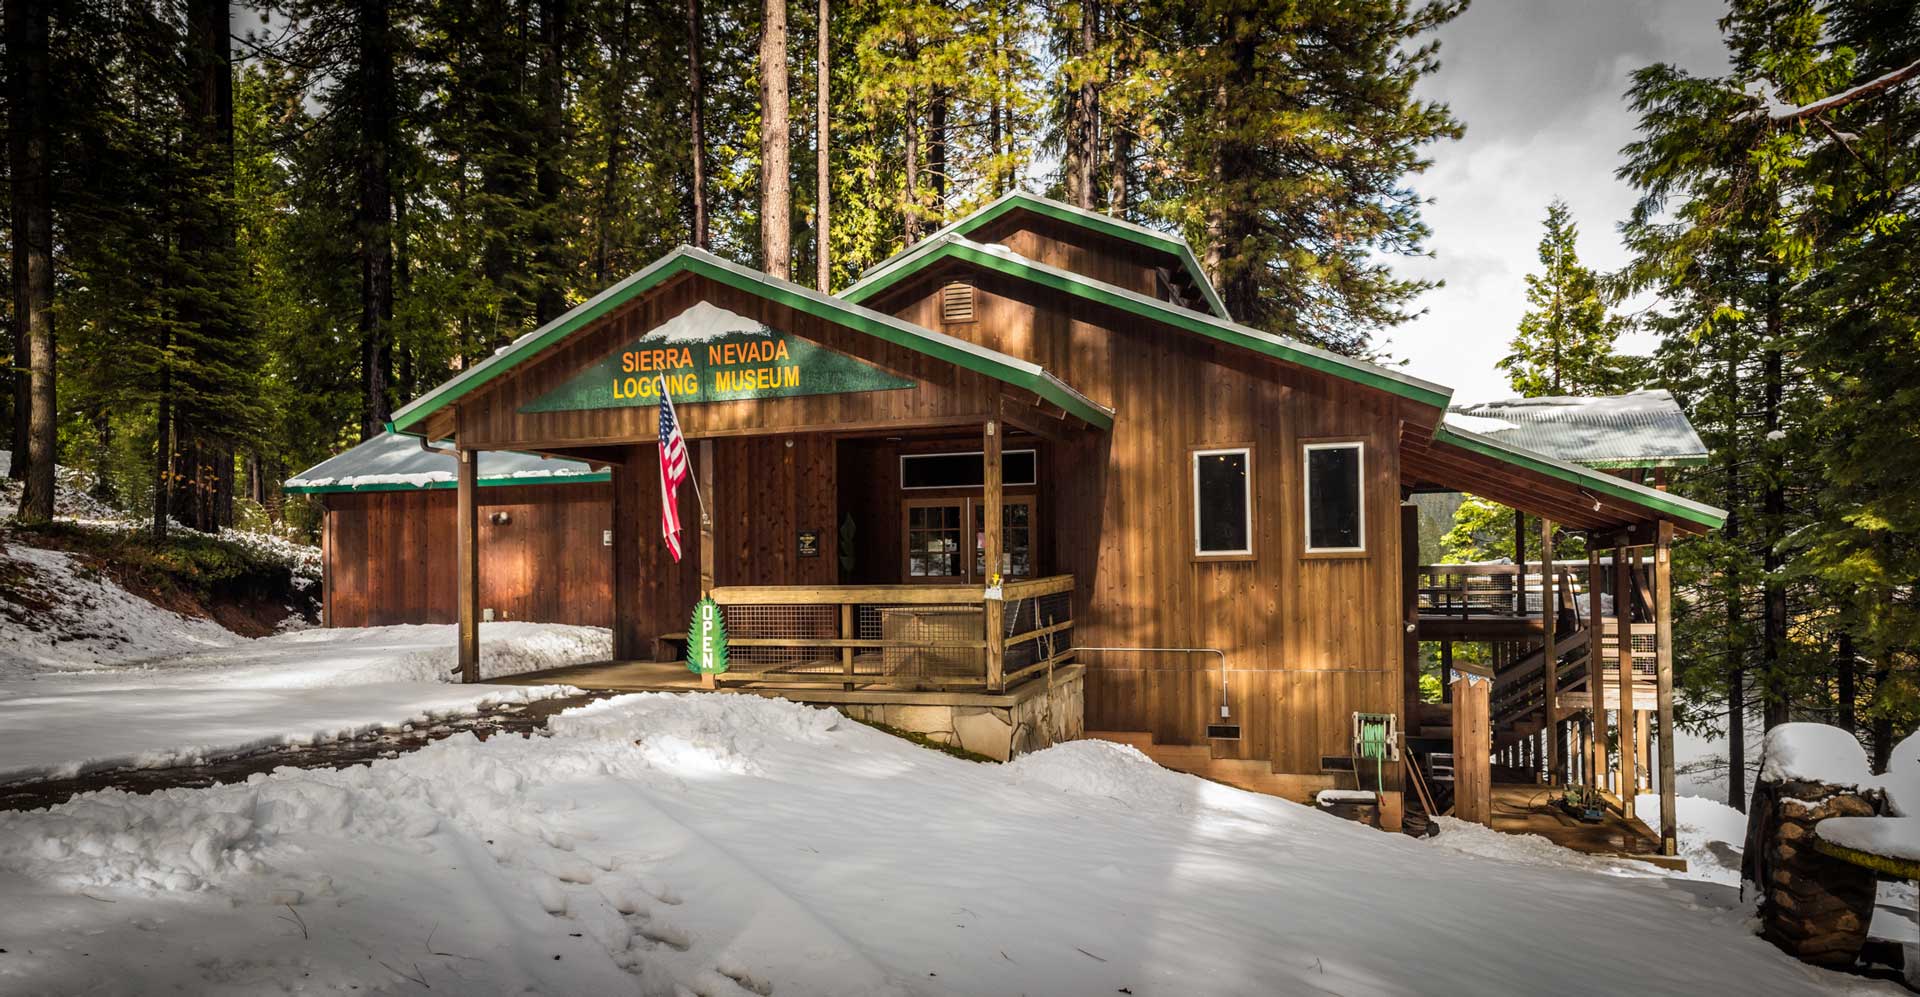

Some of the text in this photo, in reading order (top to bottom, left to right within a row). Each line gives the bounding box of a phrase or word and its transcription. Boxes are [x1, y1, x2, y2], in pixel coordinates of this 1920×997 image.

[622, 339, 790, 373] SIERRA NEVADA
[613, 365, 800, 399] LOGGING MUSEUM
[702, 605, 713, 669] OPEN
